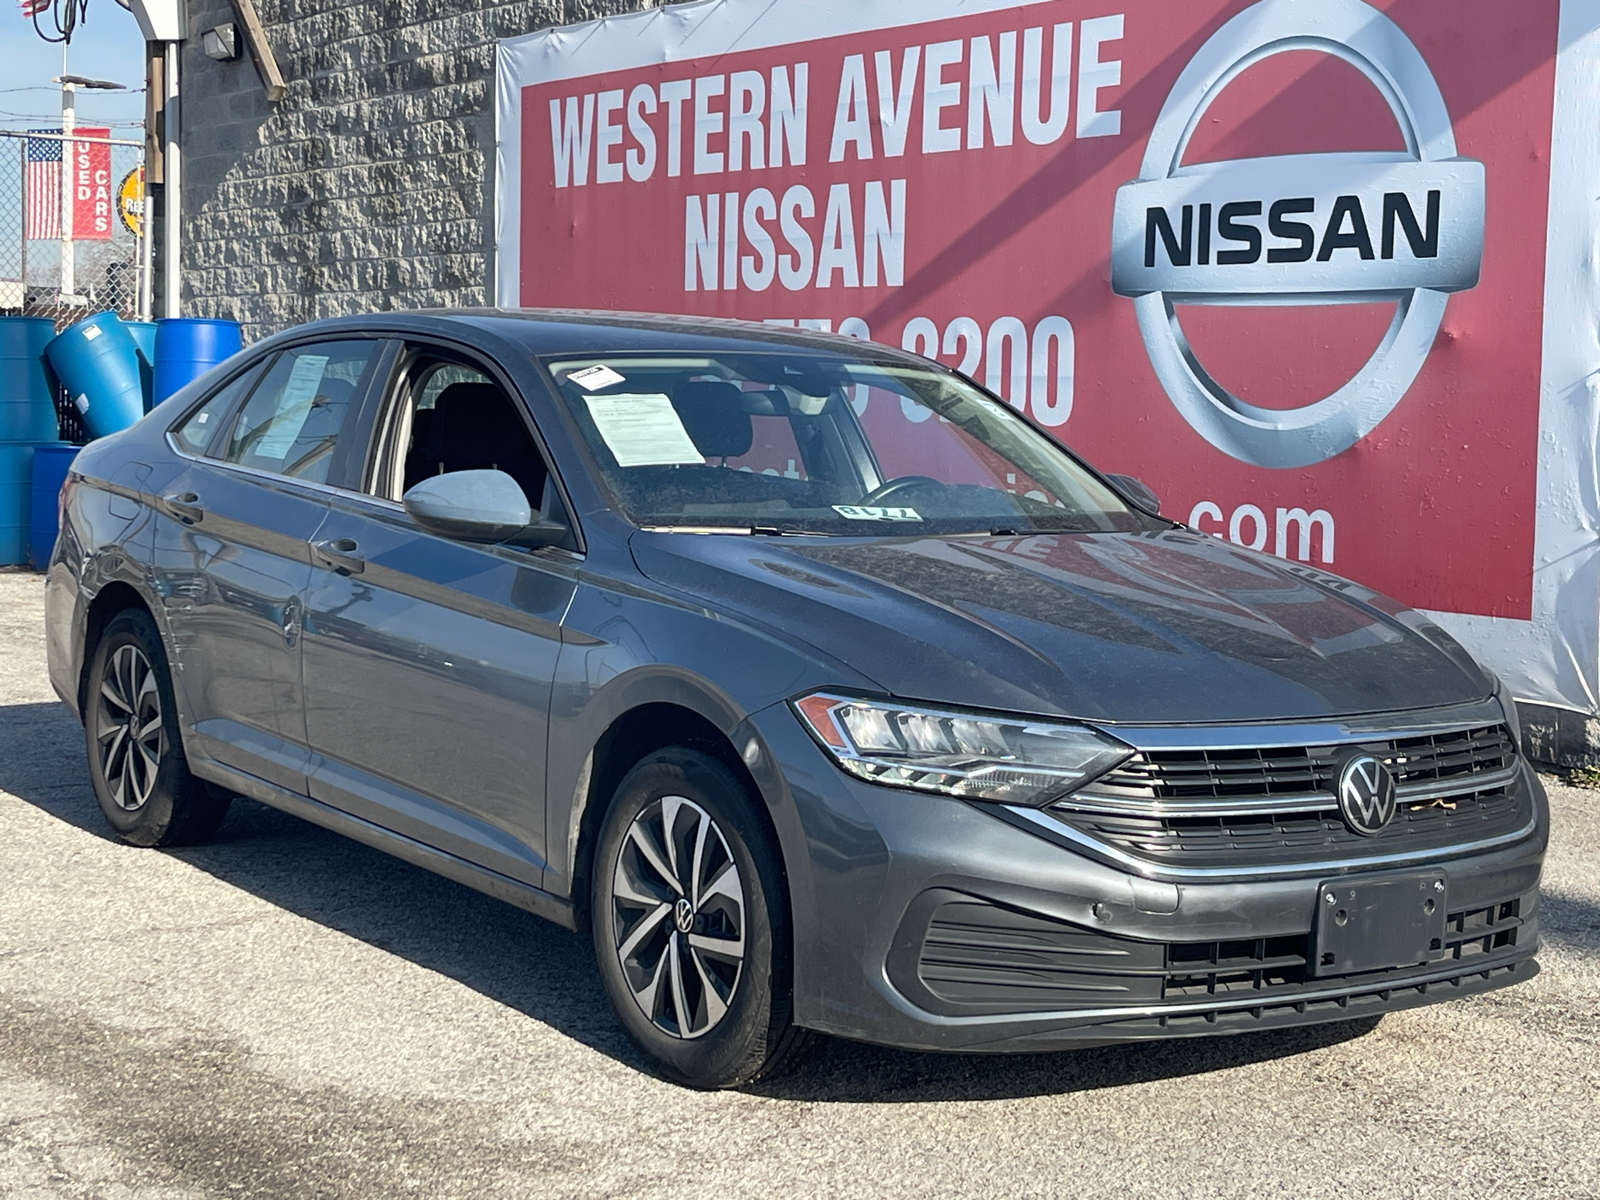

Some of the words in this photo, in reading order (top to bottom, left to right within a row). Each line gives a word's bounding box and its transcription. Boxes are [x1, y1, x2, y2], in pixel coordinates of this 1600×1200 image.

[549, 61, 809, 189] WESTERN
[828, 13, 1125, 163] AVENUE
[77, 141, 91, 200] USED
[94, 169, 108, 232] CARS
[684, 178, 907, 292] NISSAN
[1144, 189, 1441, 268] NISSAN
